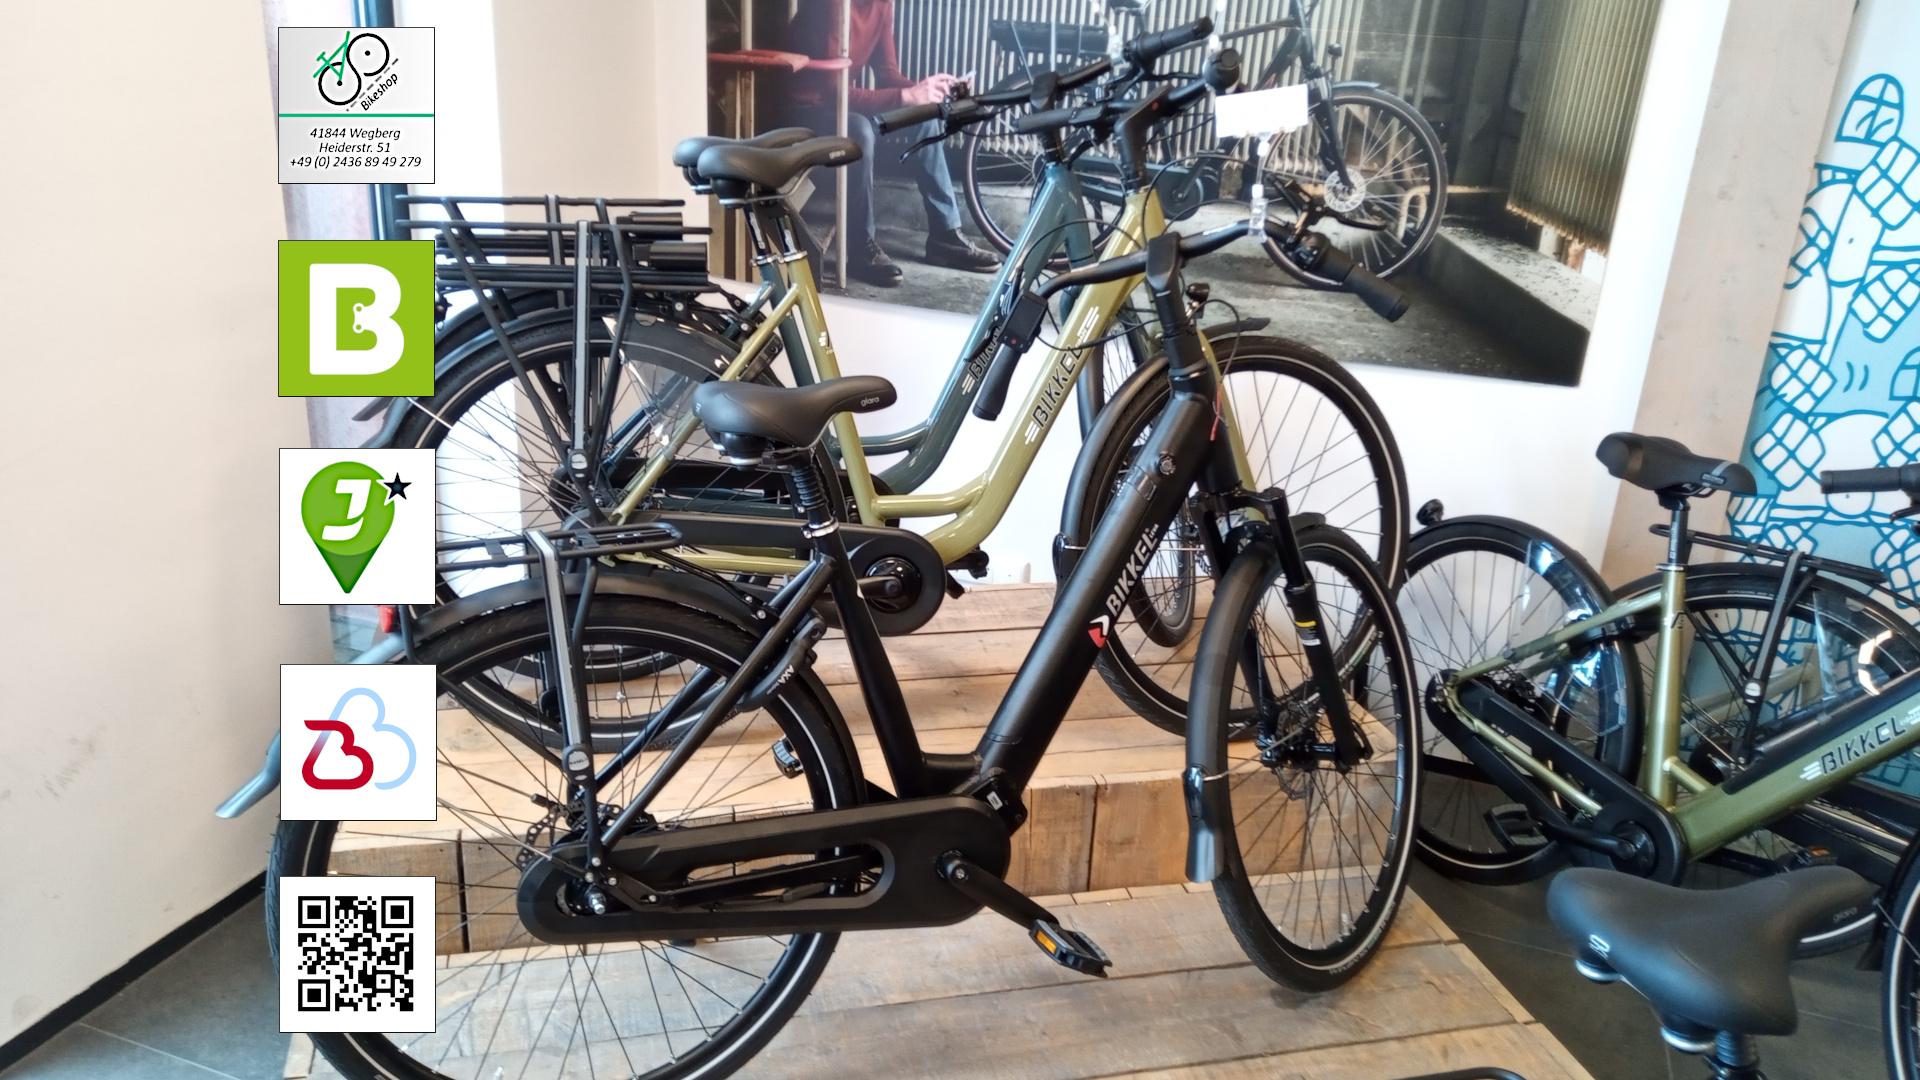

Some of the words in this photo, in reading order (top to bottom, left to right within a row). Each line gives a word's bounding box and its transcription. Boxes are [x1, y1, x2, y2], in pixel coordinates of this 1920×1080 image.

[1032, 346, 1084, 428] BIKKEL
[1105, 533, 1158, 617] BIKKEL
[1821, 717, 1906, 774] BIKKEL
